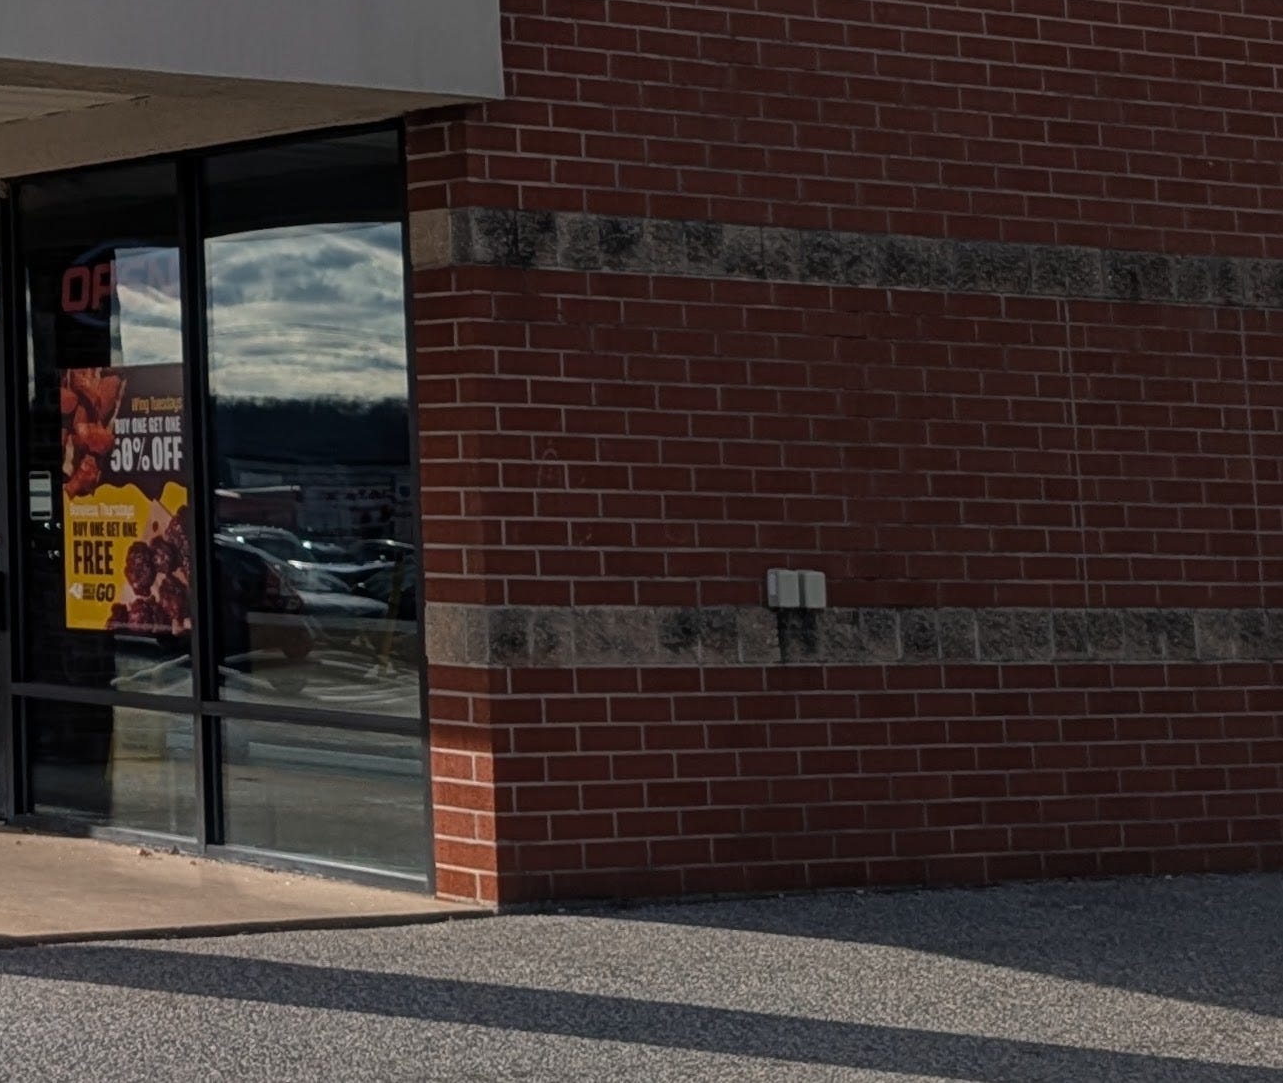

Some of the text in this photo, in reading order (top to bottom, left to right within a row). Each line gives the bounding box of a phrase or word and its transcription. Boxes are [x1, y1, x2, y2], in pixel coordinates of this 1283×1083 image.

[114, 415, 182, 434] BUY ONE GET ONE
[110, 435, 183, 472] 50% OFF
[72, 521, 138, 537] BUY ONE GET ONE
[73, 540, 114, 575] FREE
[96, 582, 116, 602] GO
